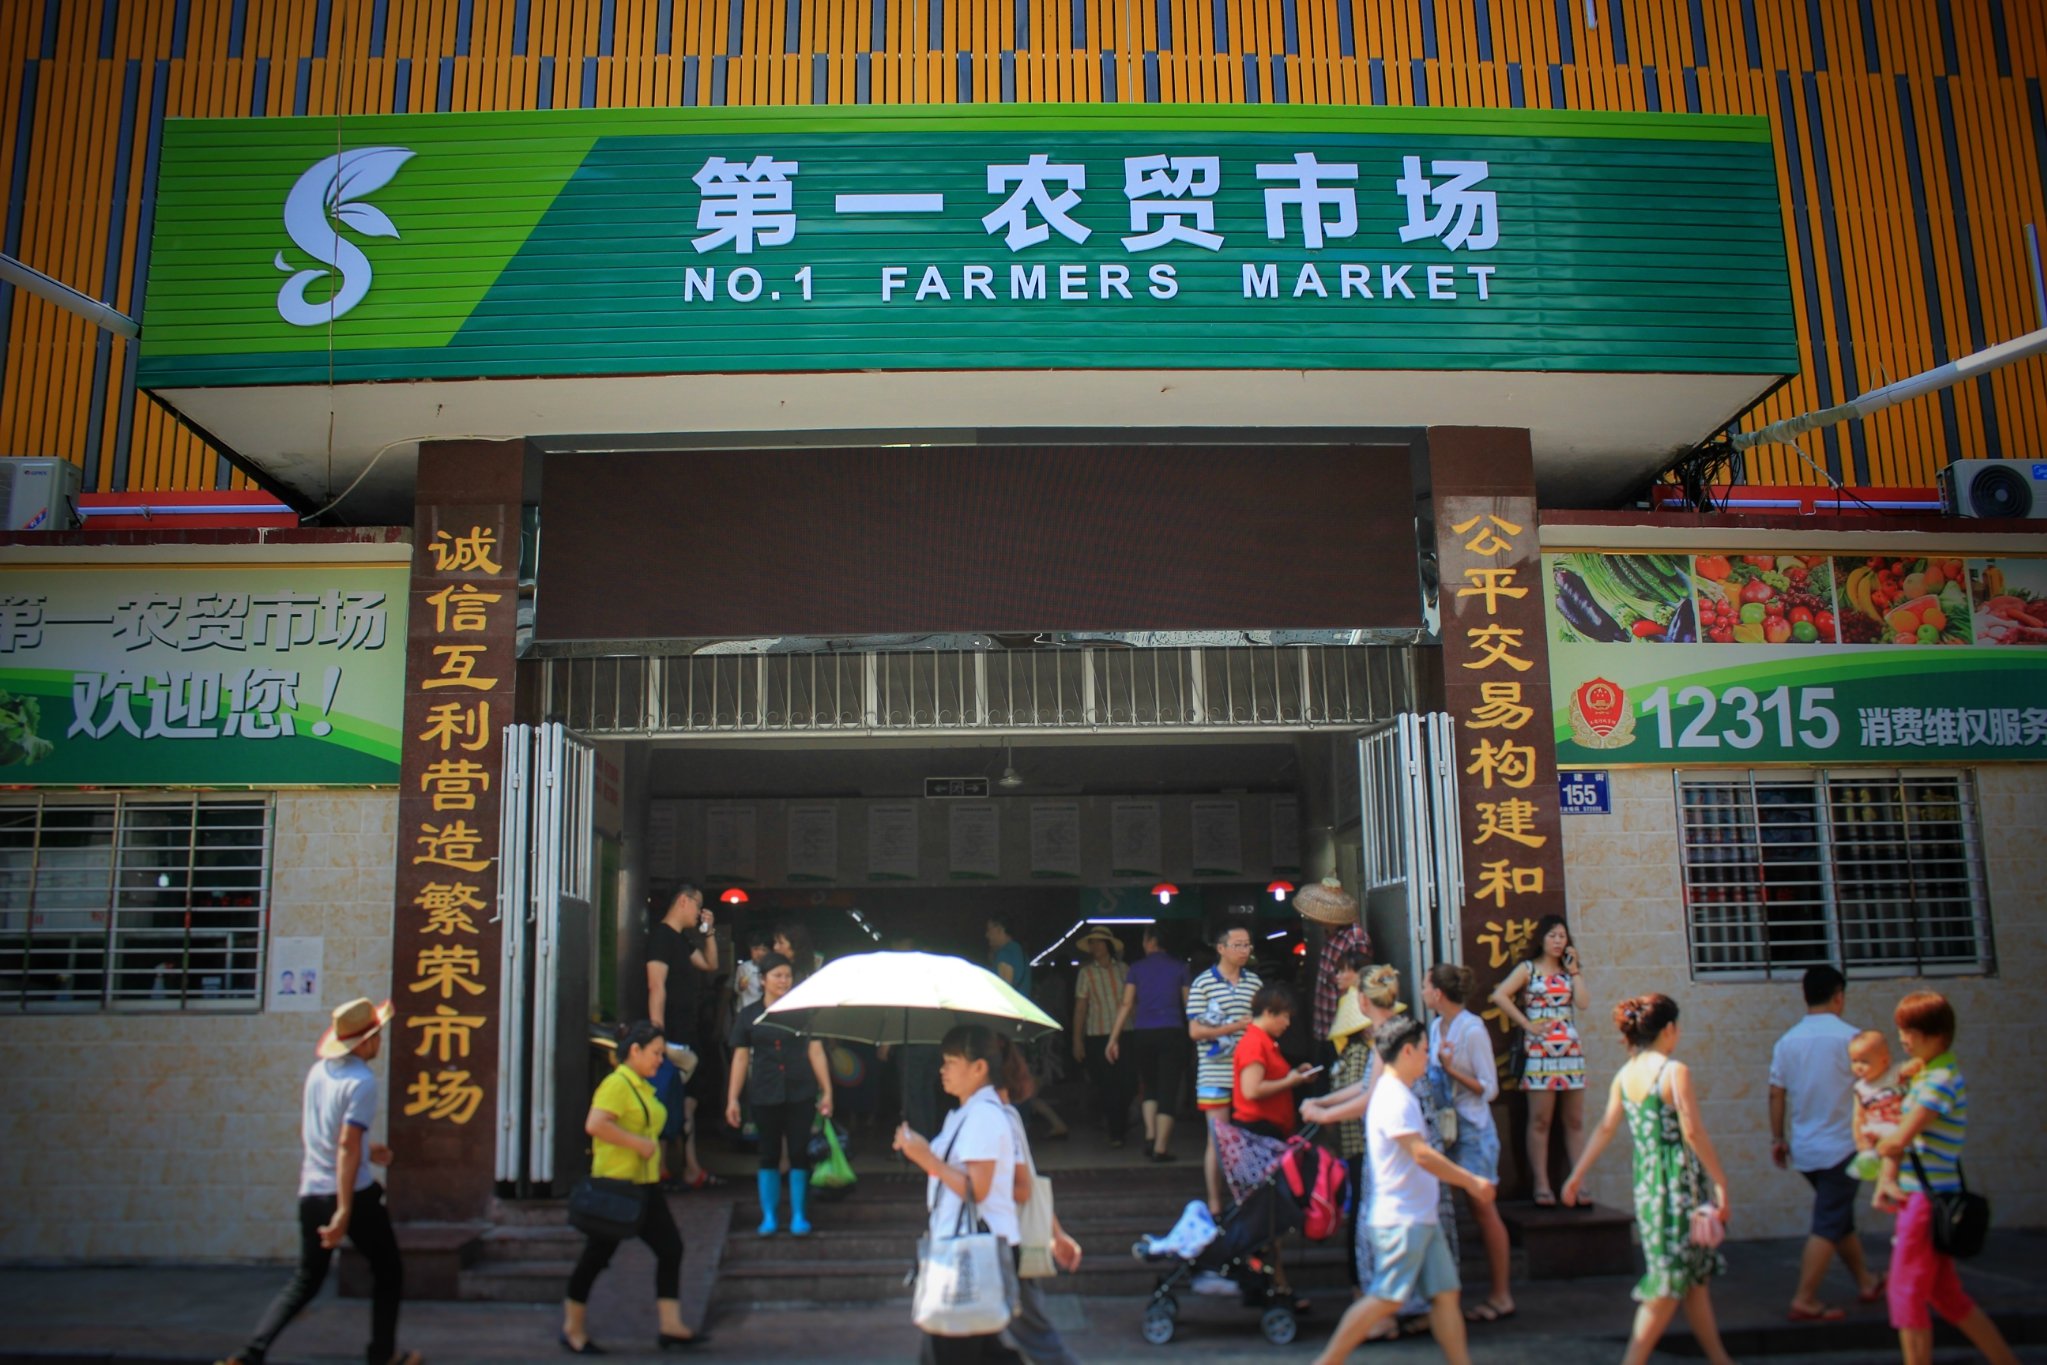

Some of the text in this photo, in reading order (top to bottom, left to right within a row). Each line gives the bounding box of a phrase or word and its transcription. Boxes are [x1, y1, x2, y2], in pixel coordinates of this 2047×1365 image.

[691, 152, 1499, 254] 第一农贸市场
[684, 263, 1496, 303] NO.1 FARMERS MARKET
[1641, 685, 2047, 749] 12315 消费维权服务
[404, 526, 503, 1125] 诚信互利营造繁荣市场
[1452, 514, 1547, 1094] 公平交易构建和谐
[1561, 783, 1598, 806] 155
